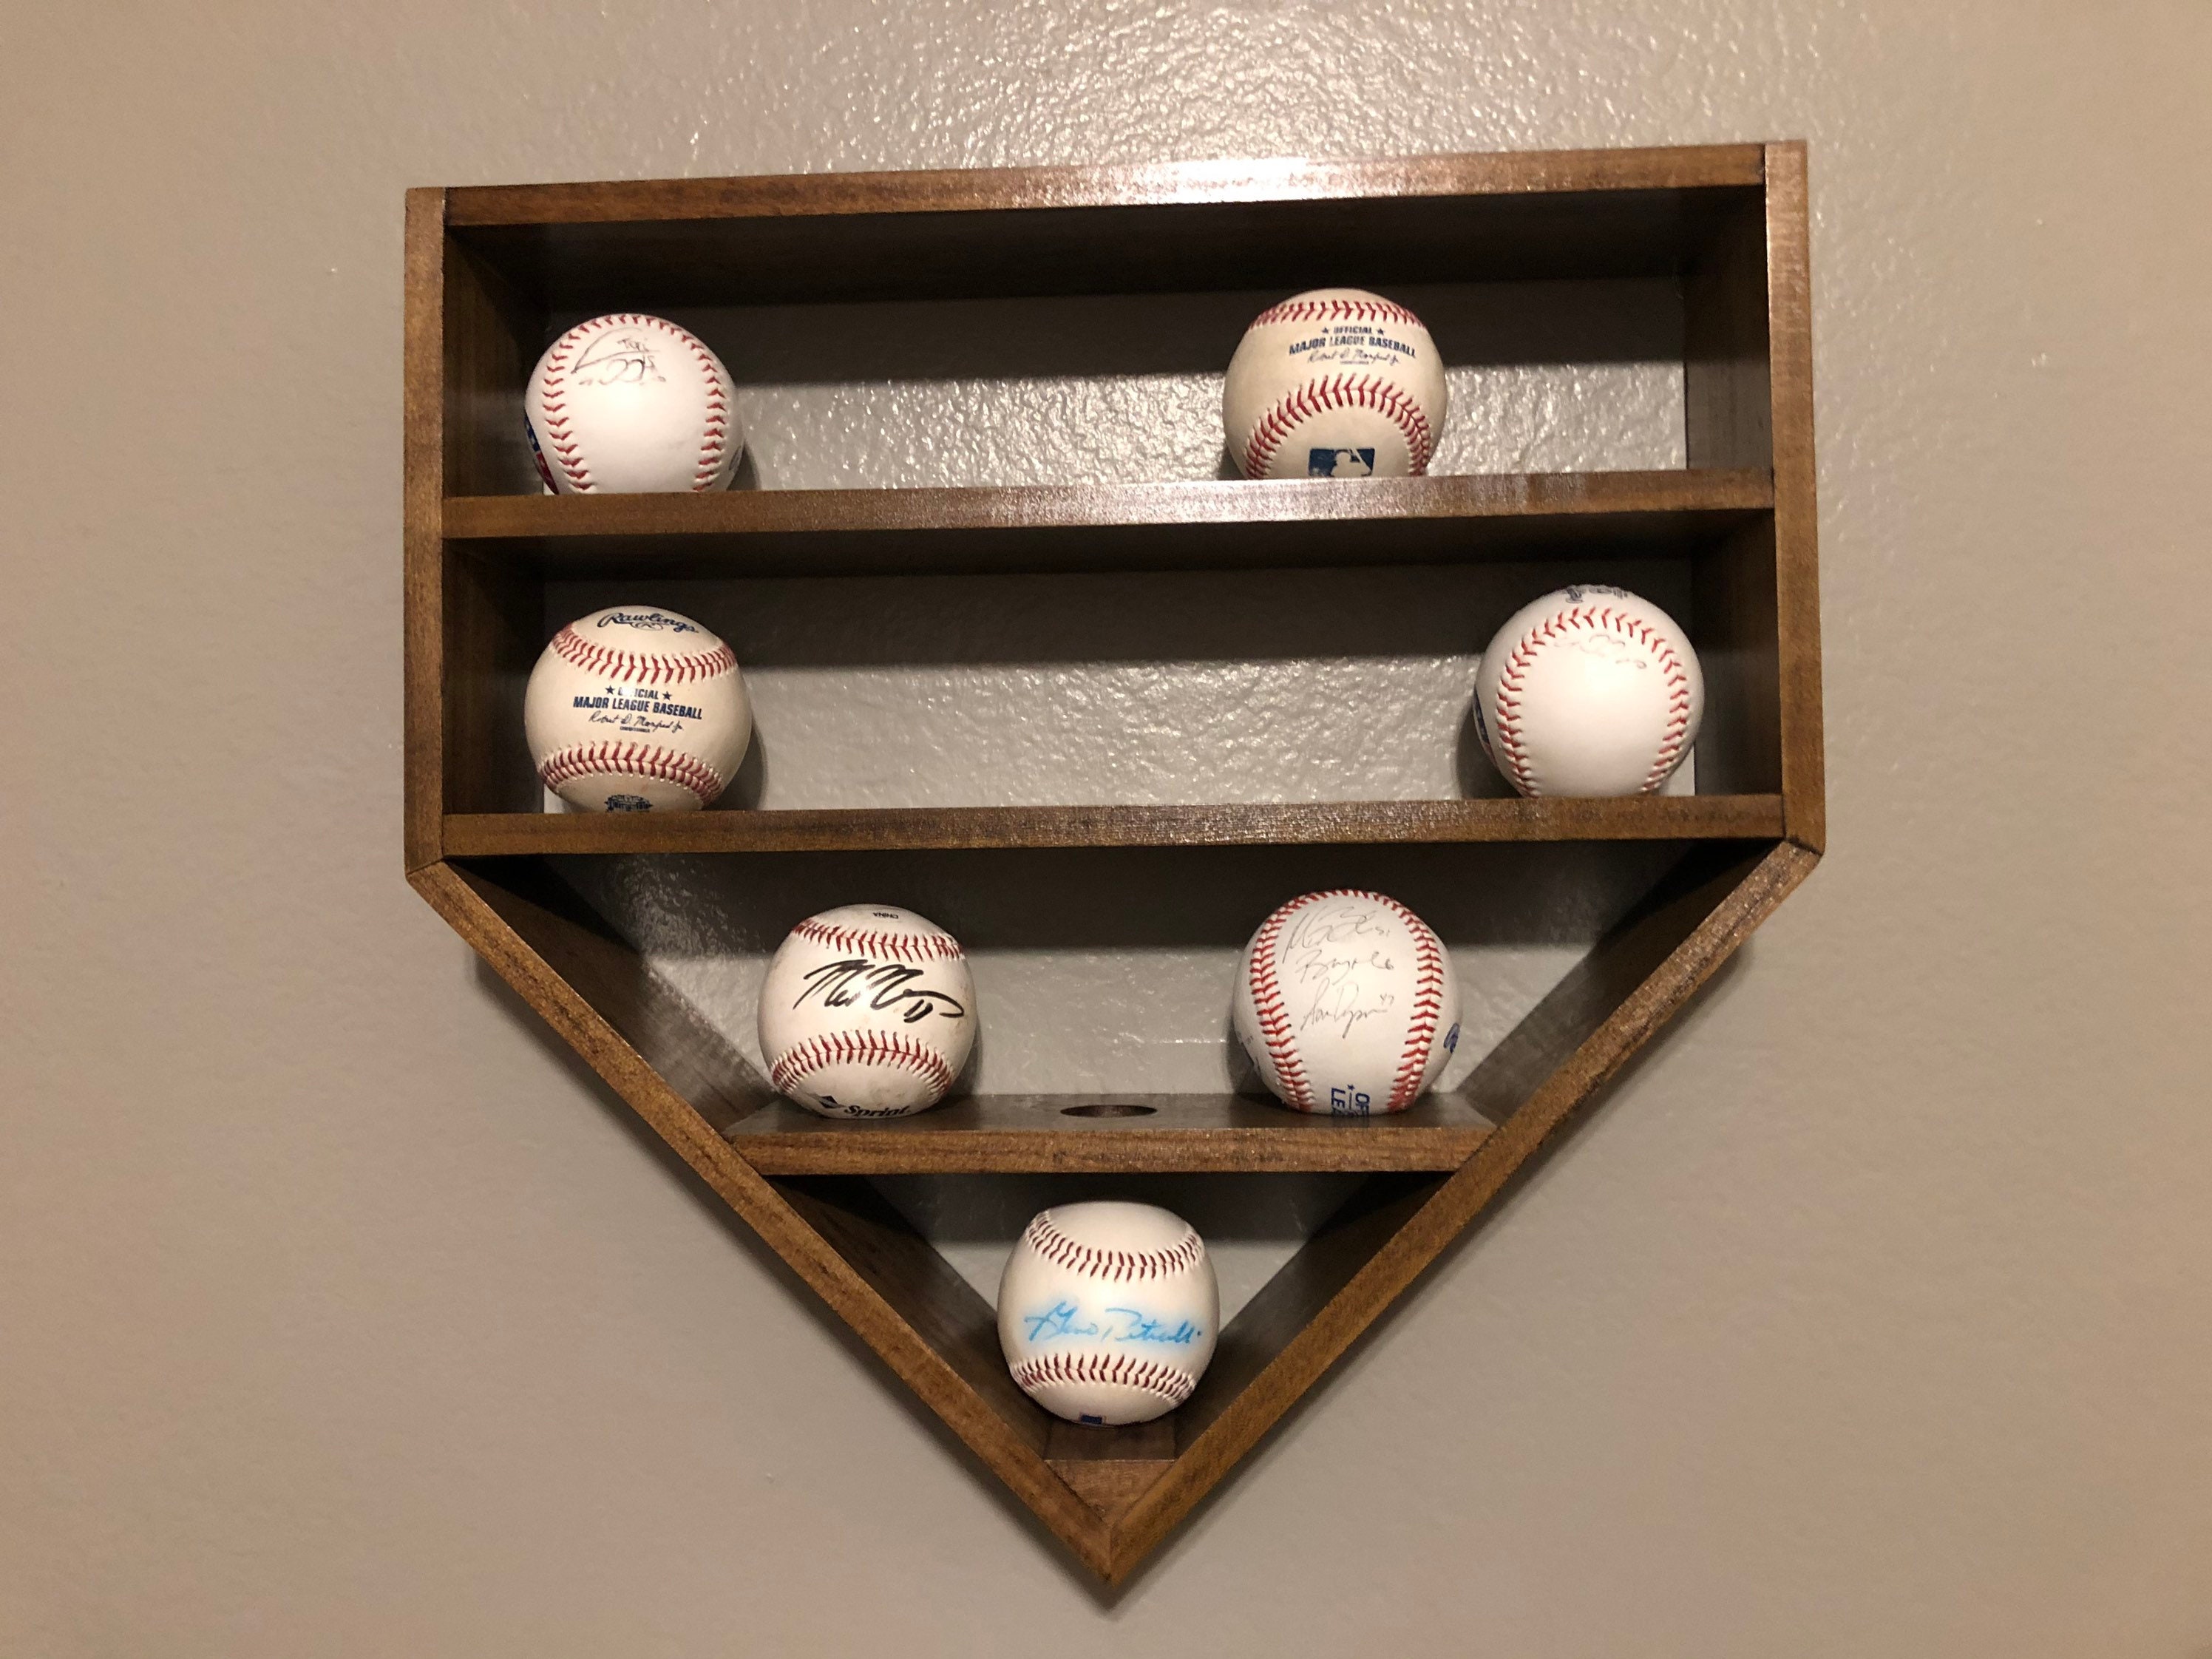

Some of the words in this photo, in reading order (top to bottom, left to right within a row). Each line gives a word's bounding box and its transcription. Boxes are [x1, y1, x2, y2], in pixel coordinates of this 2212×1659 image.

[1333, 325, 1373, 333] OFFICIAL
[1289, 337, 1326, 356] MAJOR
[1329, 336, 1365, 347] LEAGUE
[1368, 336, 1416, 359] BASEBALL
[597, 612, 699, 633] Rawlings
[573, 696, 609, 709] MAJOR
[612, 698, 650, 713] LEAGUE
[653, 702, 702, 720] BASEBALL
